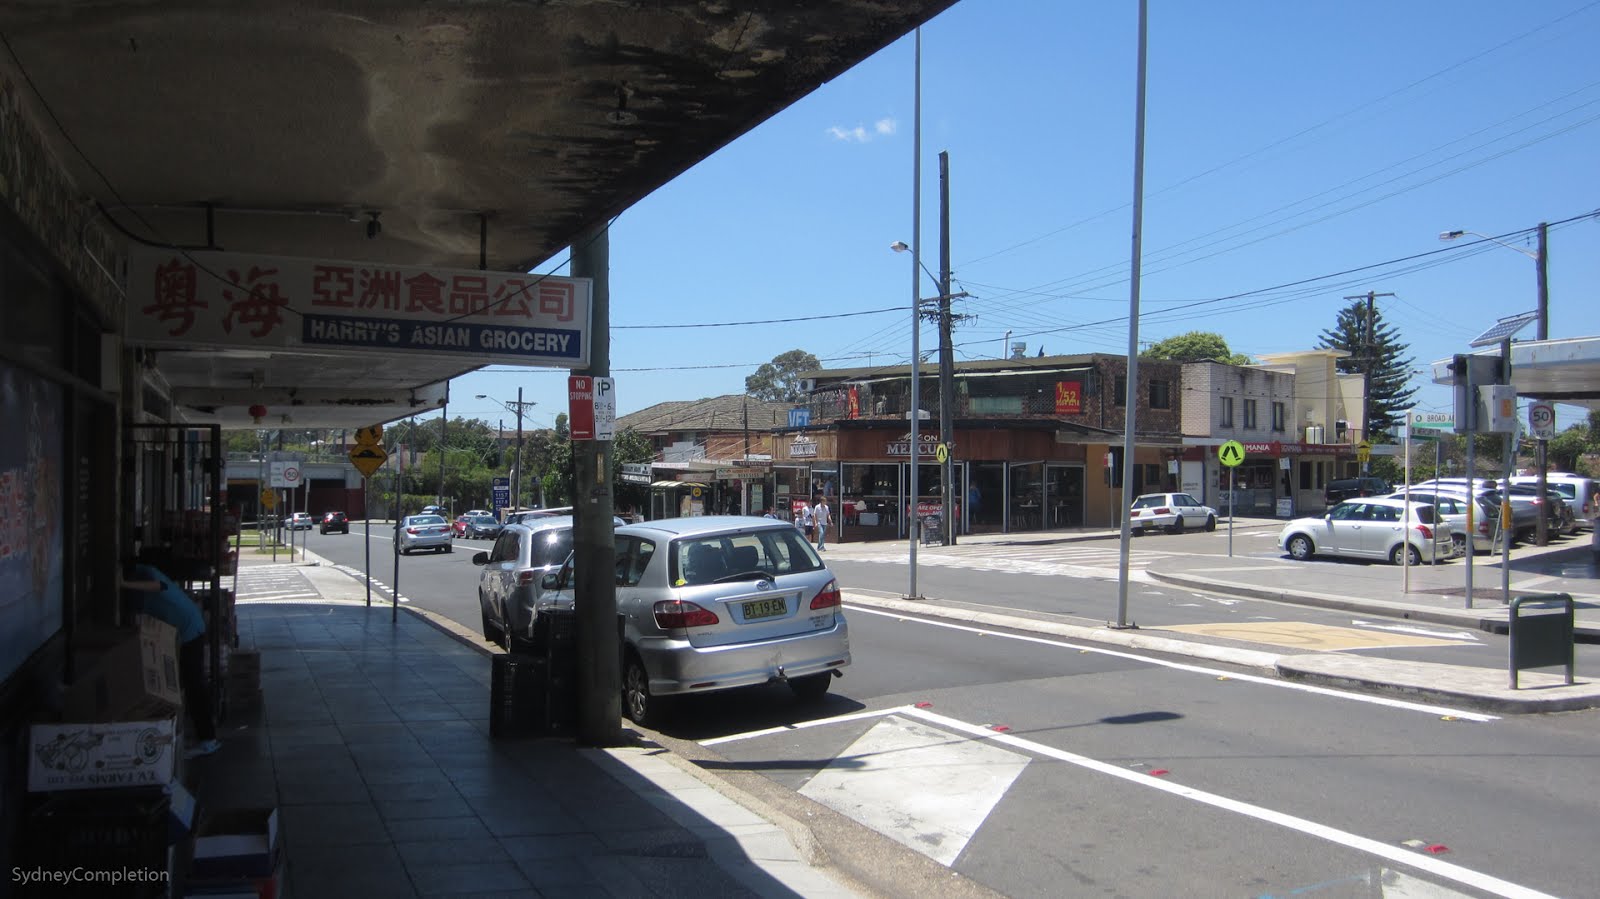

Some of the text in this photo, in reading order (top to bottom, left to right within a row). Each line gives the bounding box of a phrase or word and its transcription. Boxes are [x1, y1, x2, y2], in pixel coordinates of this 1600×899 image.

[311, 264, 575, 321] 亞洲食品公司
[311, 319, 571, 352] HARRY'S ASIAN GROCERY
[575, 380, 586, 389] NO
[598, 380, 610, 396] 1P
[570, 392, 592, 400] STOPPING
[1533, 411, 1549, 421] 50
